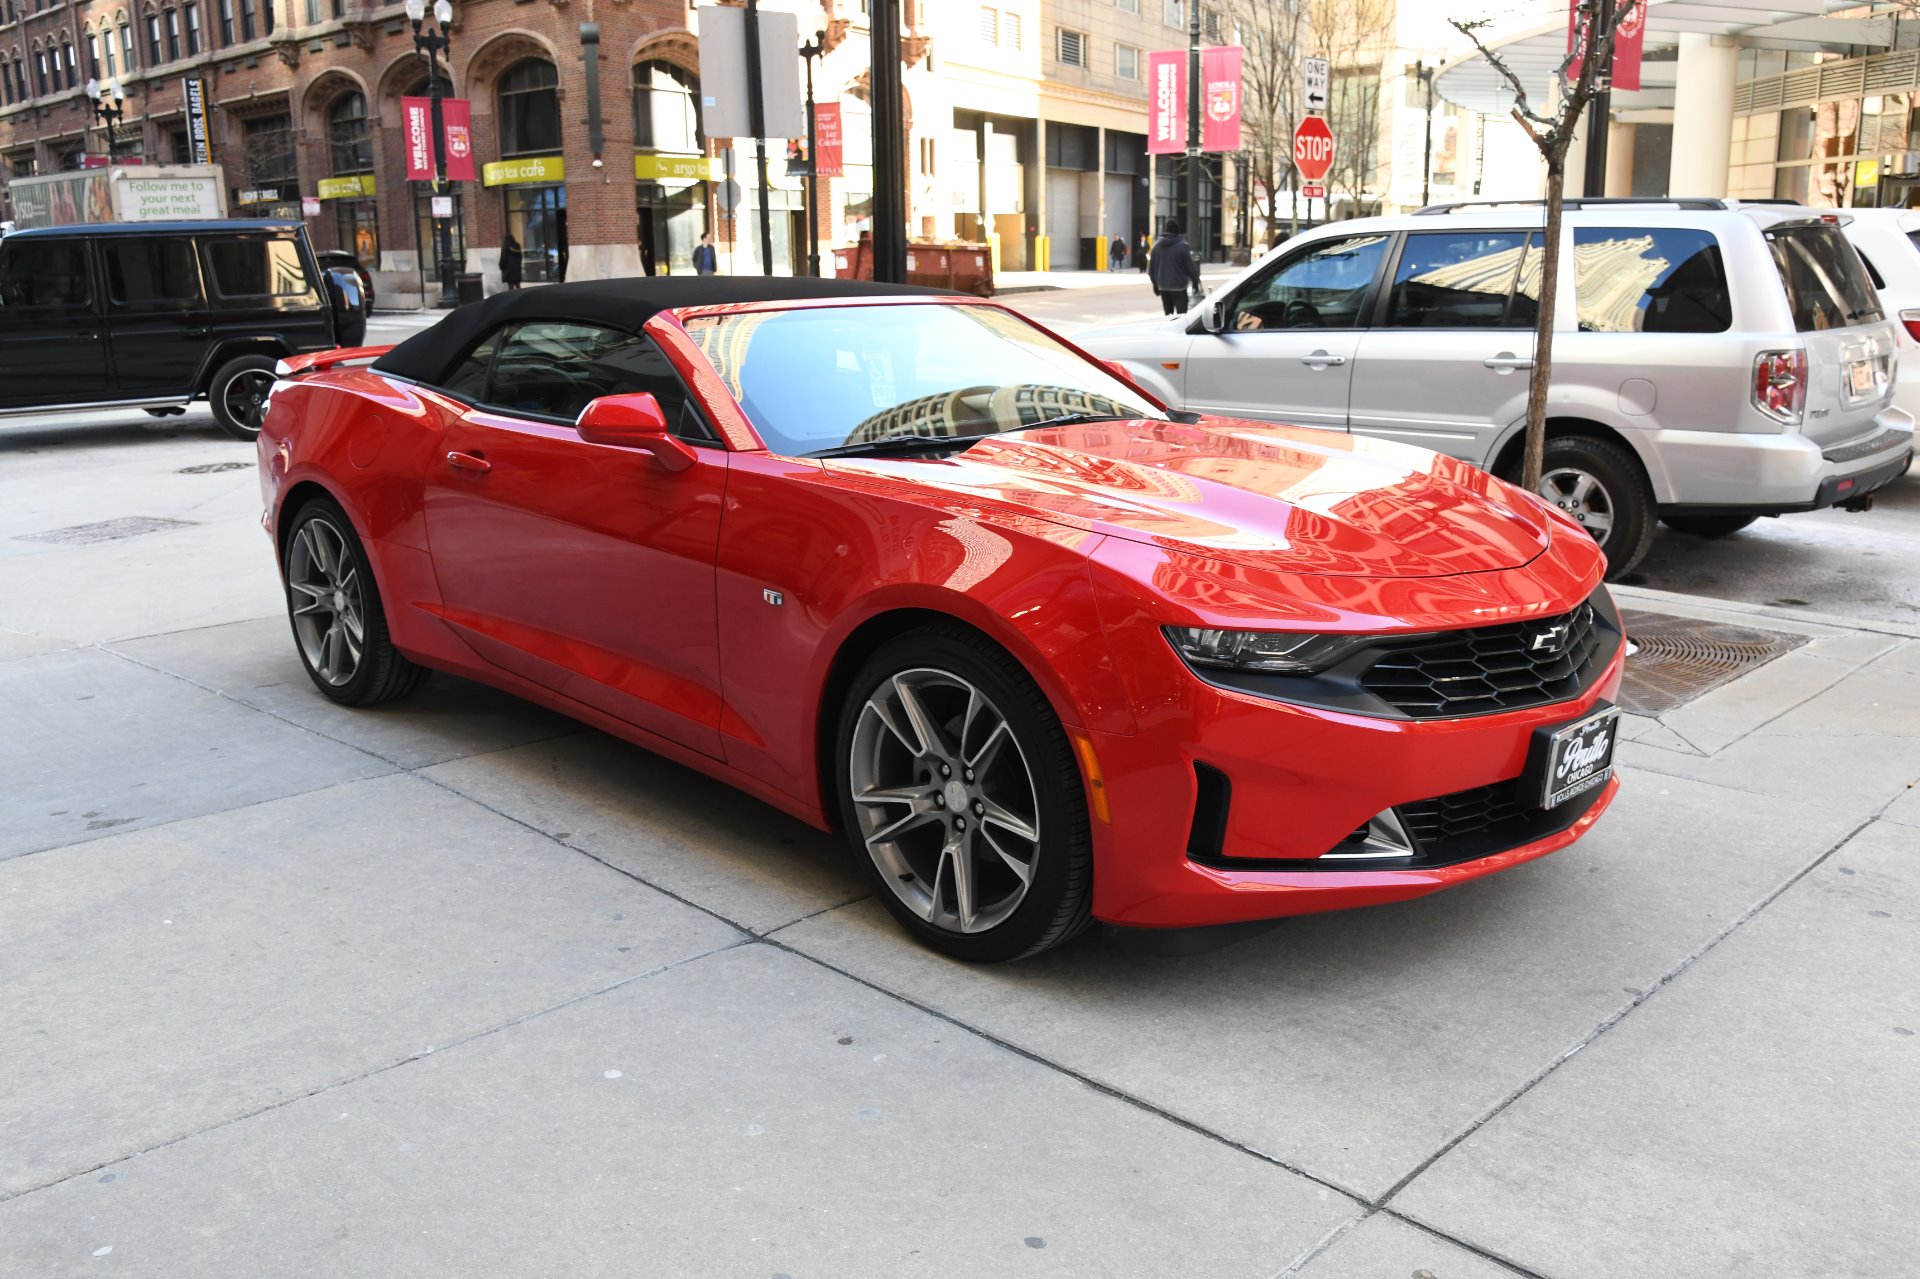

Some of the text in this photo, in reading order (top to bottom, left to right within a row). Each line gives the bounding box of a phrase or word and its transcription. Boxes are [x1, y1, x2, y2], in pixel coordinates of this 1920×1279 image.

[1307, 62, 1325, 76] ONE
[1307, 78, 1325, 89] WAY
[188, 80, 203, 114] BAGELS
[1157, 64, 1170, 141] WELCOME
[409, 106, 424, 170] WELCOME
[1296, 135, 1331, 161] STOP
[520, 160, 545, 178] café
[674, 164, 696, 177] argo
[129, 181, 167, 192] Follow
[192, 182, 204, 191] to
[141, 194, 196, 206] your next
[139, 204, 200, 218] great meal
[1567, 764, 1594, 785] CHICAGO
[1556, 790, 1570, 803] ROLLS
[1584, 773, 1604, 789] CHICAGO
